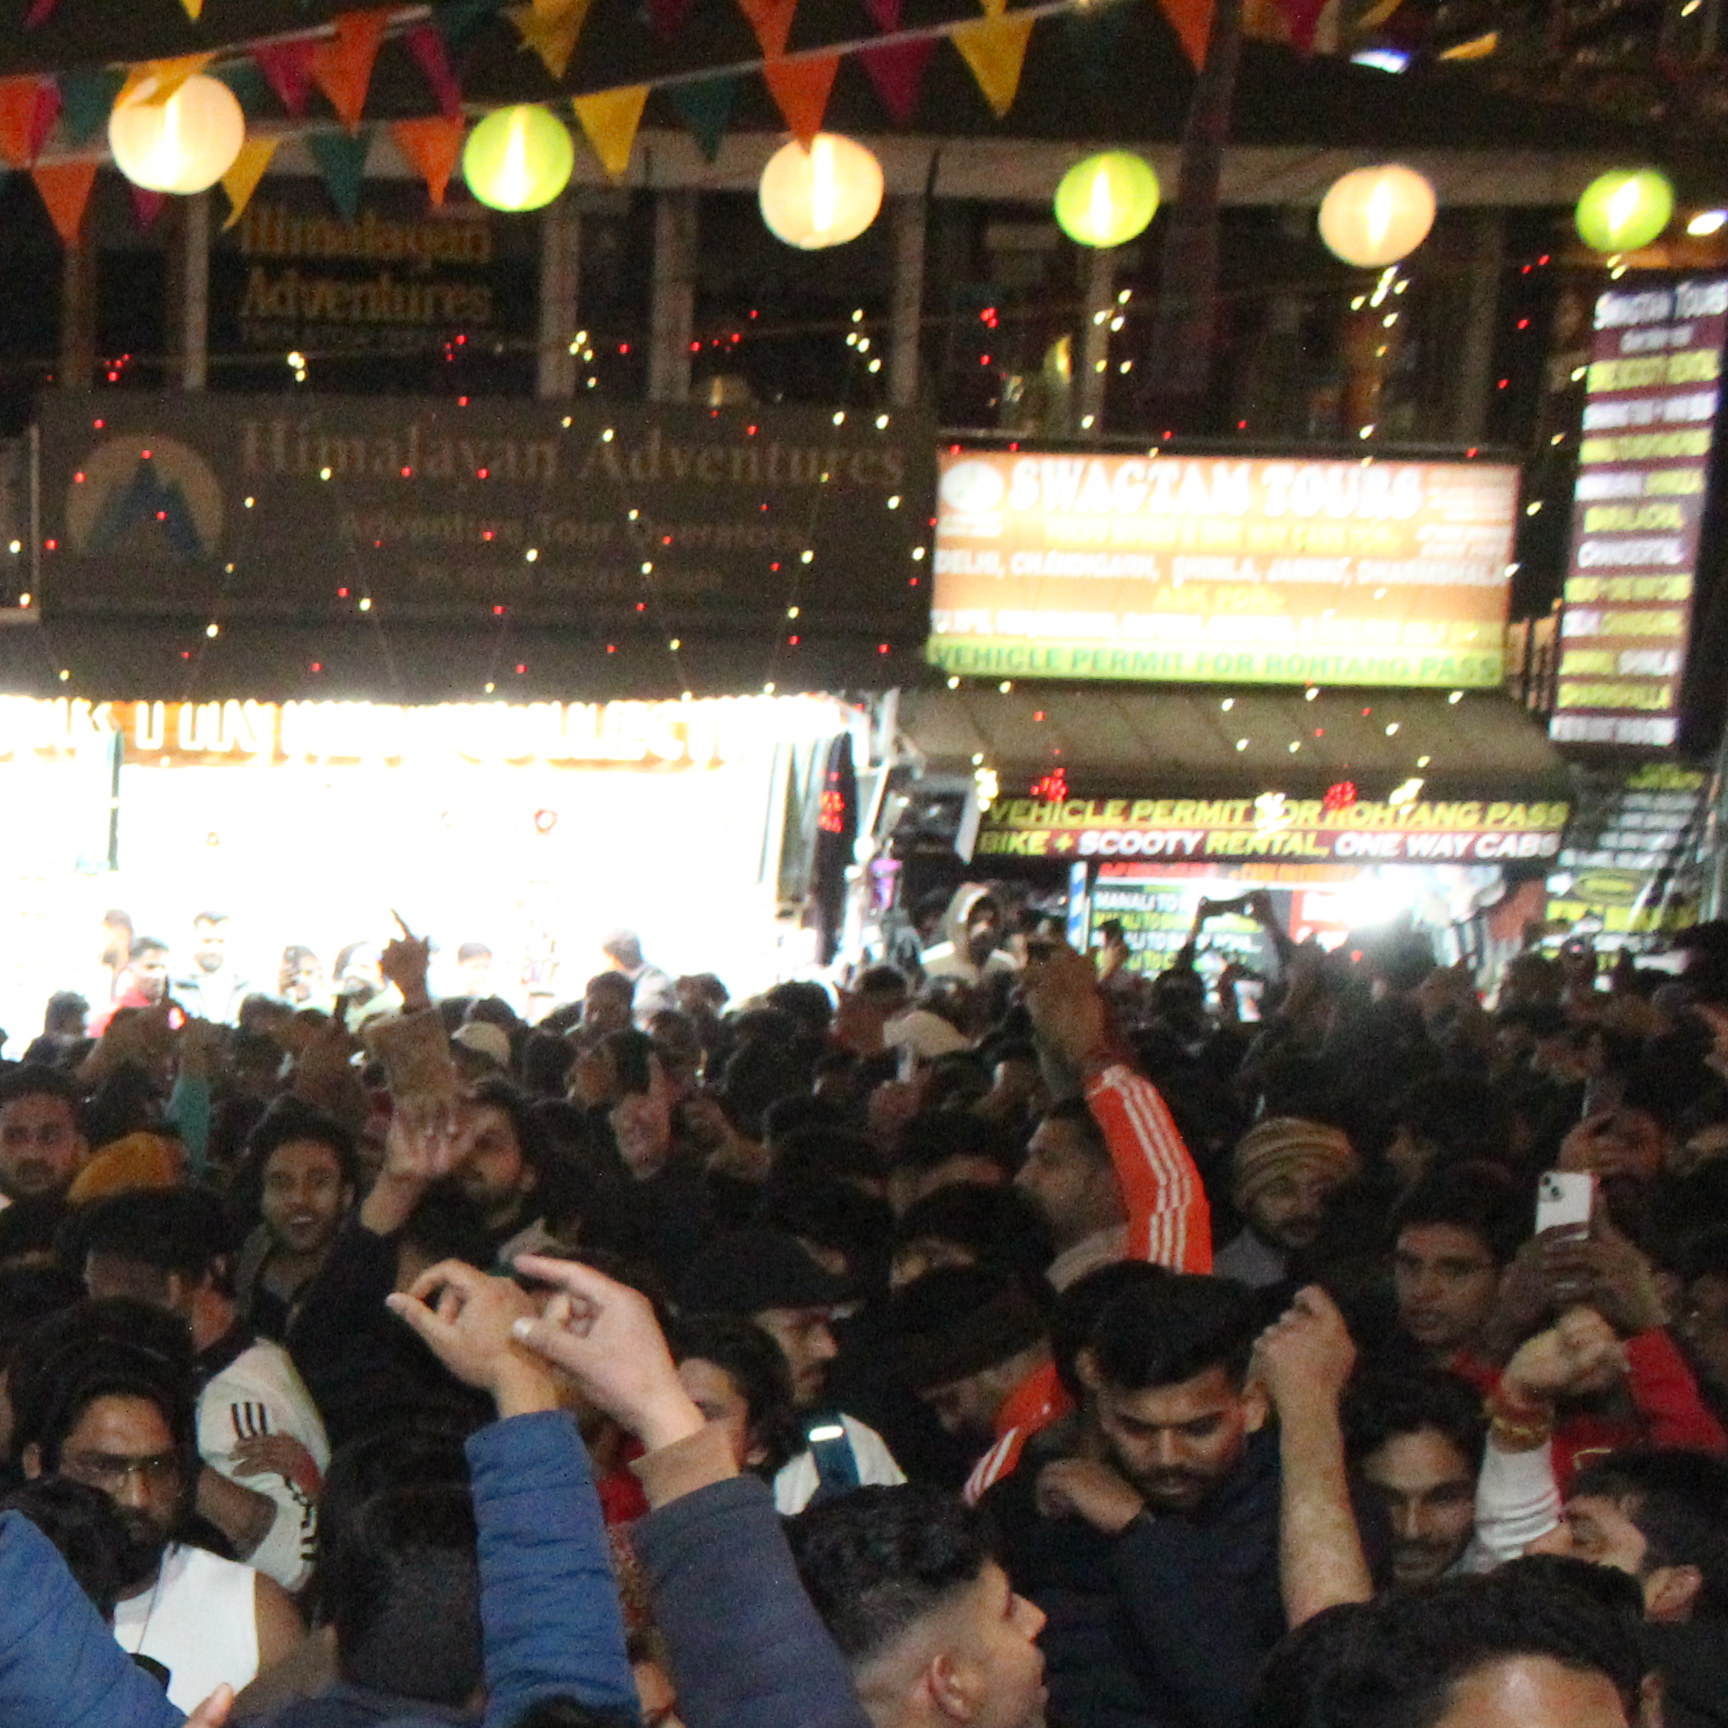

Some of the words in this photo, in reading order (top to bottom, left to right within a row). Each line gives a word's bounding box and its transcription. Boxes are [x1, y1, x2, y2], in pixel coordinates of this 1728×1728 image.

[577, 425, 912, 486] Adventures
[1008, 458, 1252, 516] SWAGTAM
[1259, 463, 1424, 521] TOURS
[932, 646, 1062, 672] VEHICLE
[1072, 648, 1186, 676] PERMIT
[1195, 653, 1254, 679] FOR
[1264, 654, 1408, 681] ROHTANG
[1418, 657, 1501, 682] PASS
[991, 799, 1127, 826] VEHICLE
[1130, 800, 1251, 826] PERMIT
[1484, 801, 1568, 828] PASS
[980, 830, 1049, 855] BIKE
[1079, 830, 1204, 856] SCOOTY
[1205, 831, 1329, 857] RENTAL,
[1335, 832, 1401, 857] ONE
[1405, 833, 1473, 858] WAY
[1474, 833, 1560, 858] CABS
